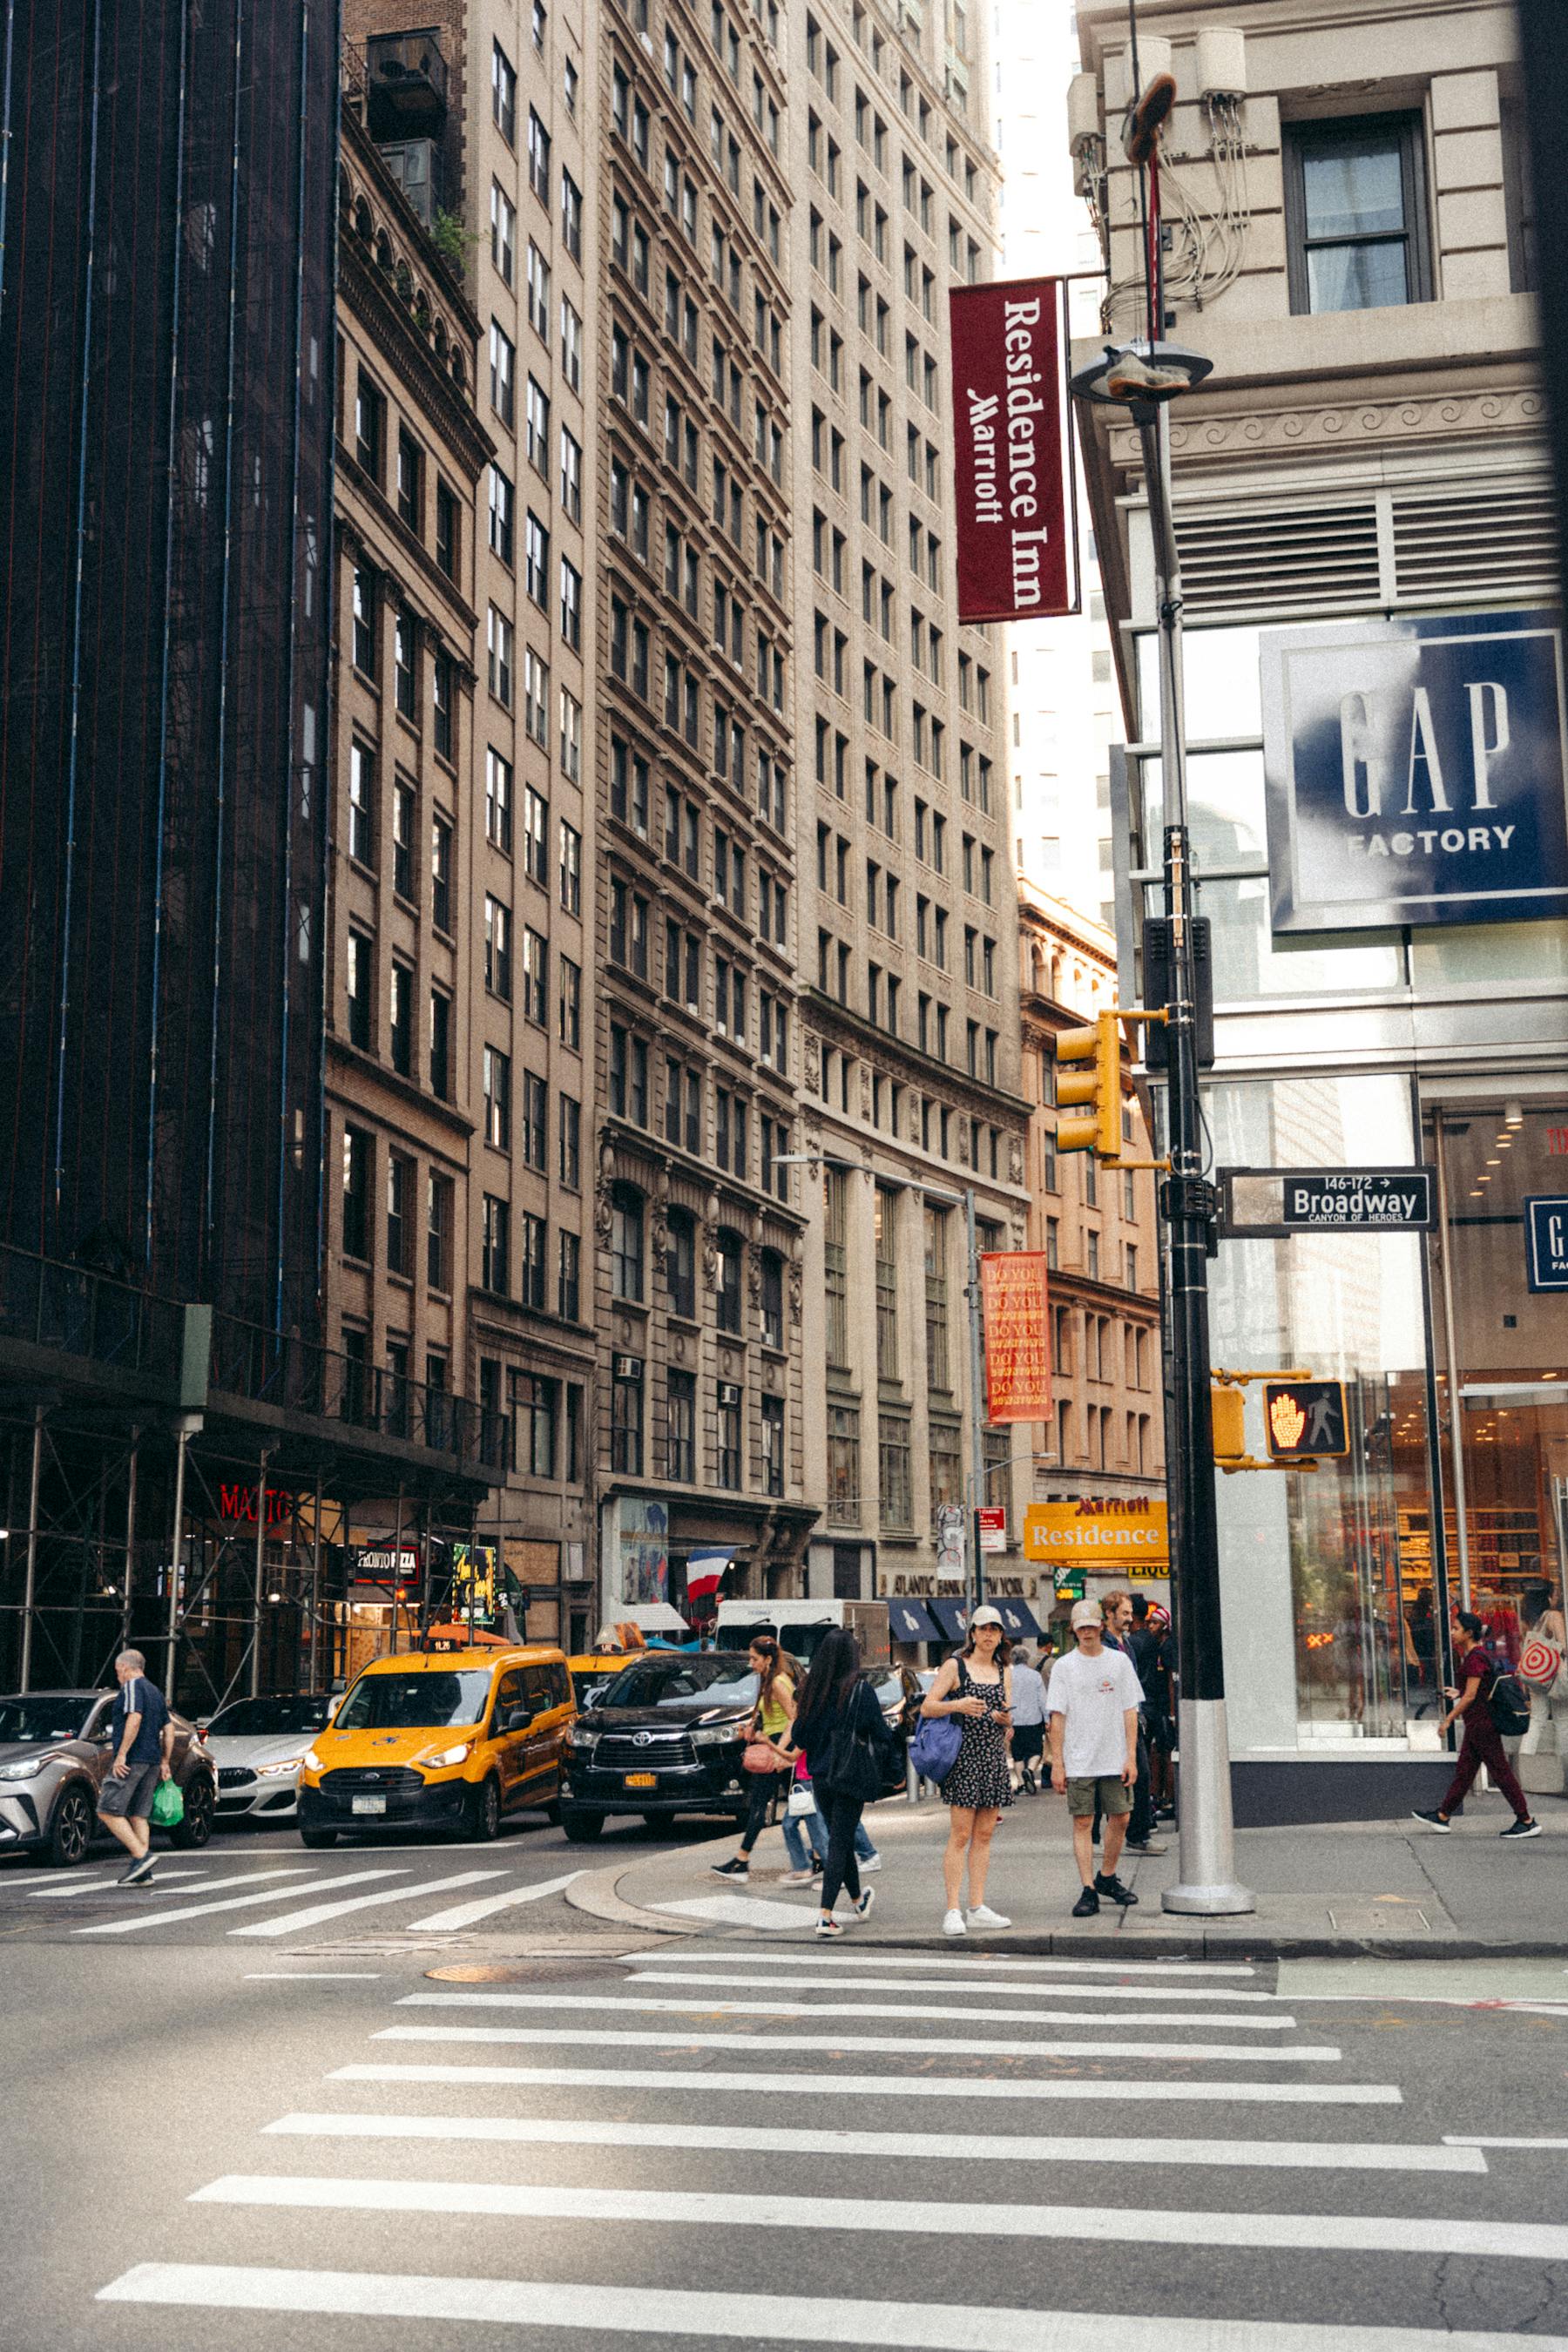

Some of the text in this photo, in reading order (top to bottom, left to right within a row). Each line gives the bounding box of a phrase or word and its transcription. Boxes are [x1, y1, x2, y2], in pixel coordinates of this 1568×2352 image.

[967, 389, 1003, 523] Marriott
[1004, 298, 1048, 609] Residence Inn
[1340, 682, 1510, 818] GAP
[1347, 825, 1516, 857] FACTORY
[1325, 1177, 1372, 1189] 146-172
[1294, 1189, 1416, 1219] Broadway
[1308, 1213, 1403, 1222] CANYON OF HEROES
[987, 1267, 1043, 1281] DO YOU
[989, 1295, 1042, 1308] DO YOU
[990, 1324, 1044, 1337] DO YOU
[990, 1352, 1044, 1365] DO YOU
[991, 1382, 1045, 1394] DO YOU
[1075, 1497, 1149, 1516] Marriott
[1032, 1525, 1159, 1546] Residence
[357, 1551, 389, 1569] PRONTO
[893, 1575, 935, 1595] ATLANTIC
[1000, 1578, 1024, 1596] YORK
